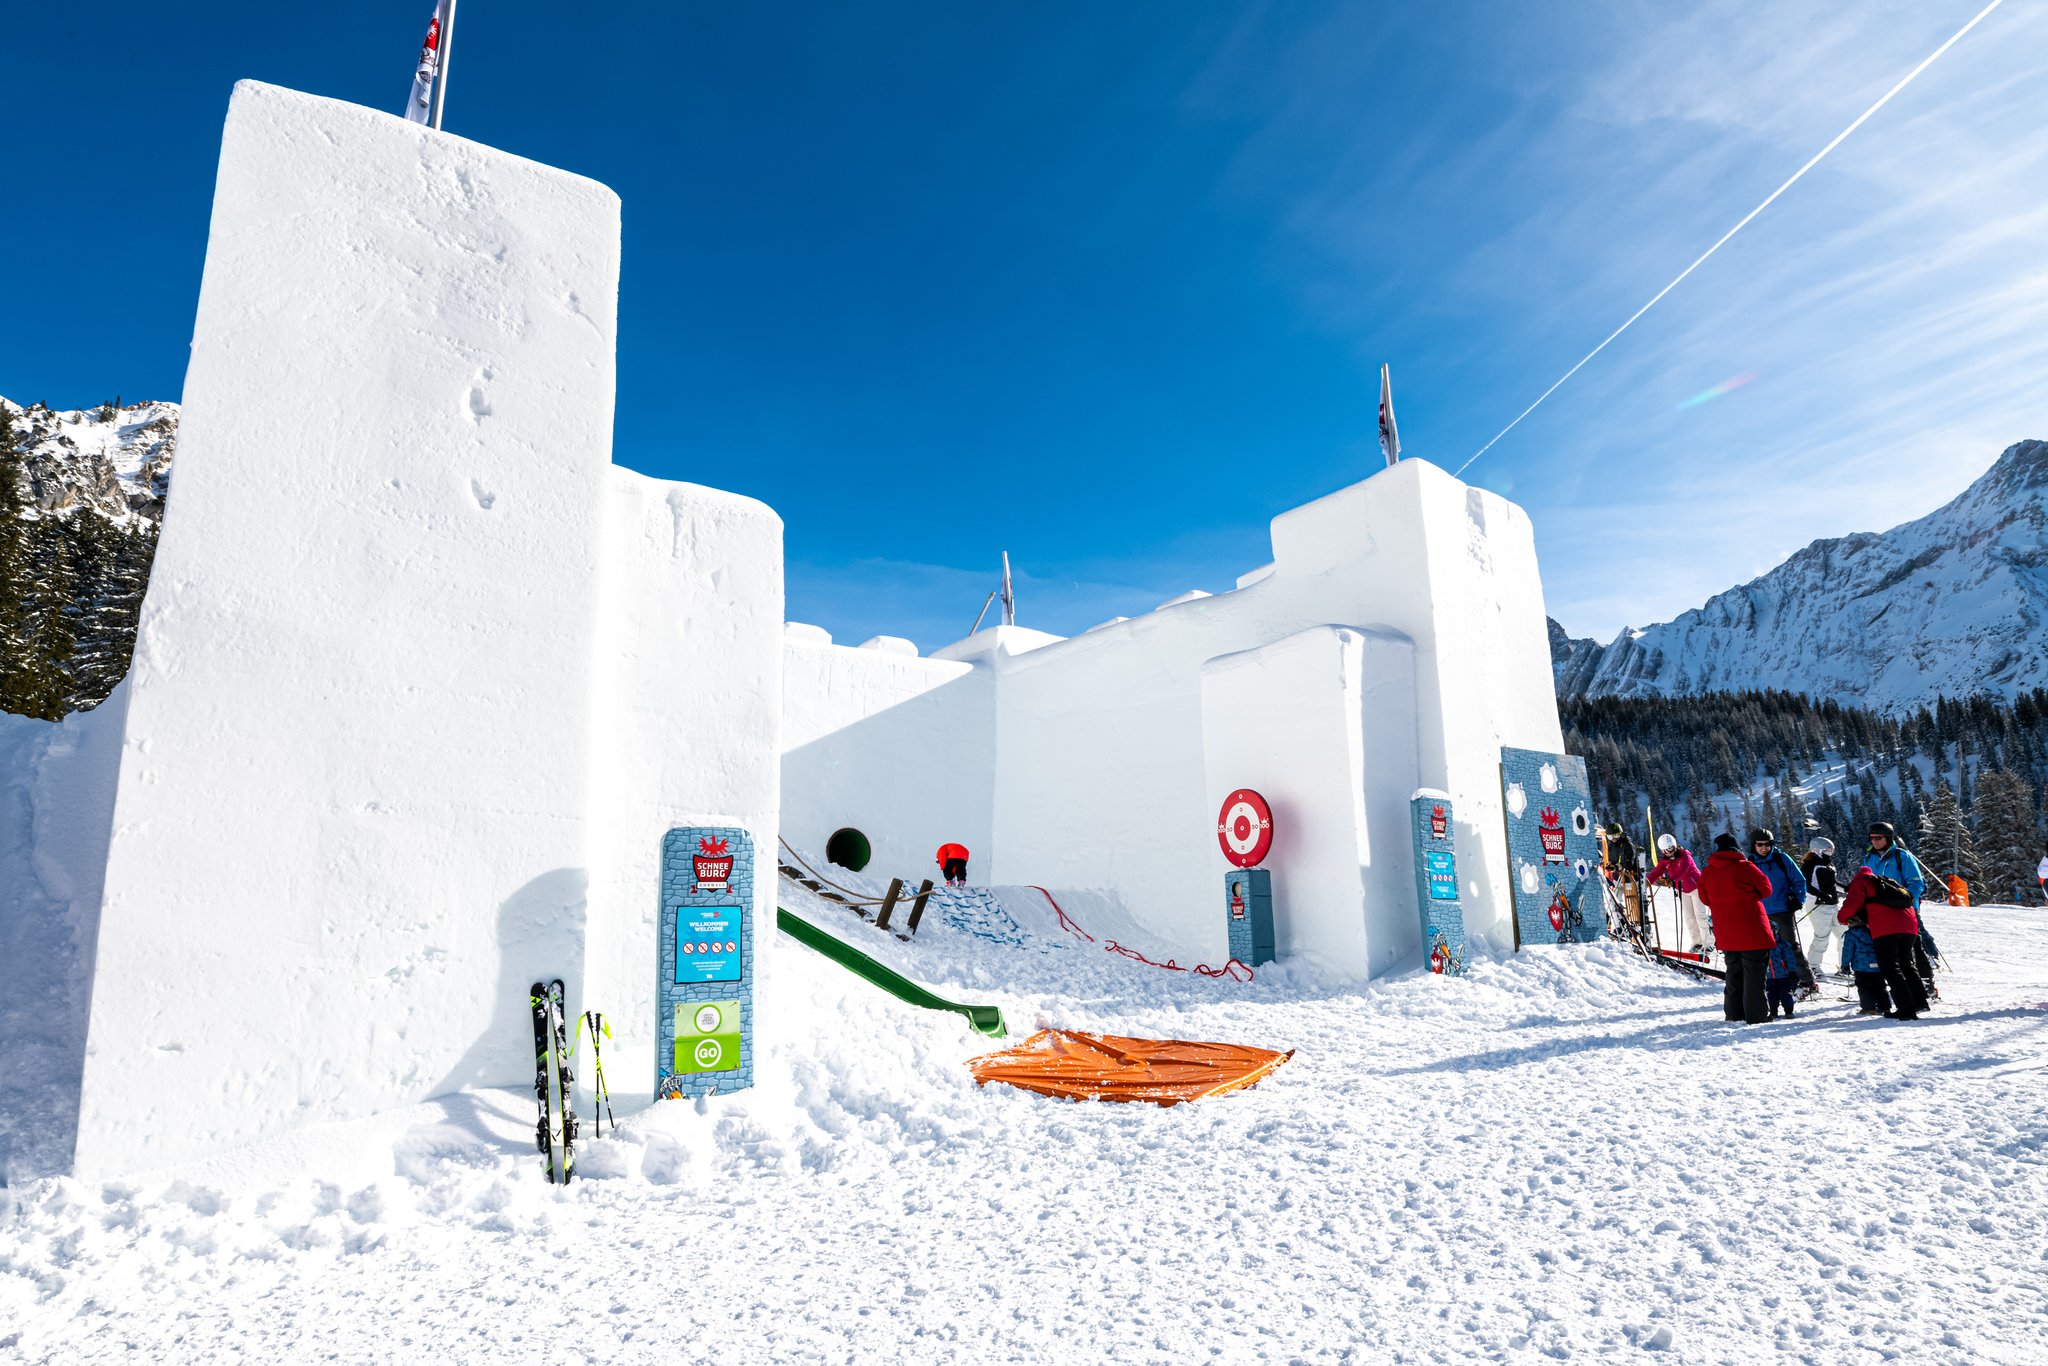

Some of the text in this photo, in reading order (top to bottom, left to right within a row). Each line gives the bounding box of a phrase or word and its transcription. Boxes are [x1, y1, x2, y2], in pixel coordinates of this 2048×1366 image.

[1557, 781, 1563, 790] 2
[1579, 800, 1585, 808] 3
[1542, 833, 1563, 842] SCHNEE
[1545, 841, 1562, 850] BURG
[697, 862, 729, 870] SCHNEE
[1587, 859, 1593, 867] 5
[700, 869, 726, 878] BURG
[699, 1047, 717, 1059] GO
